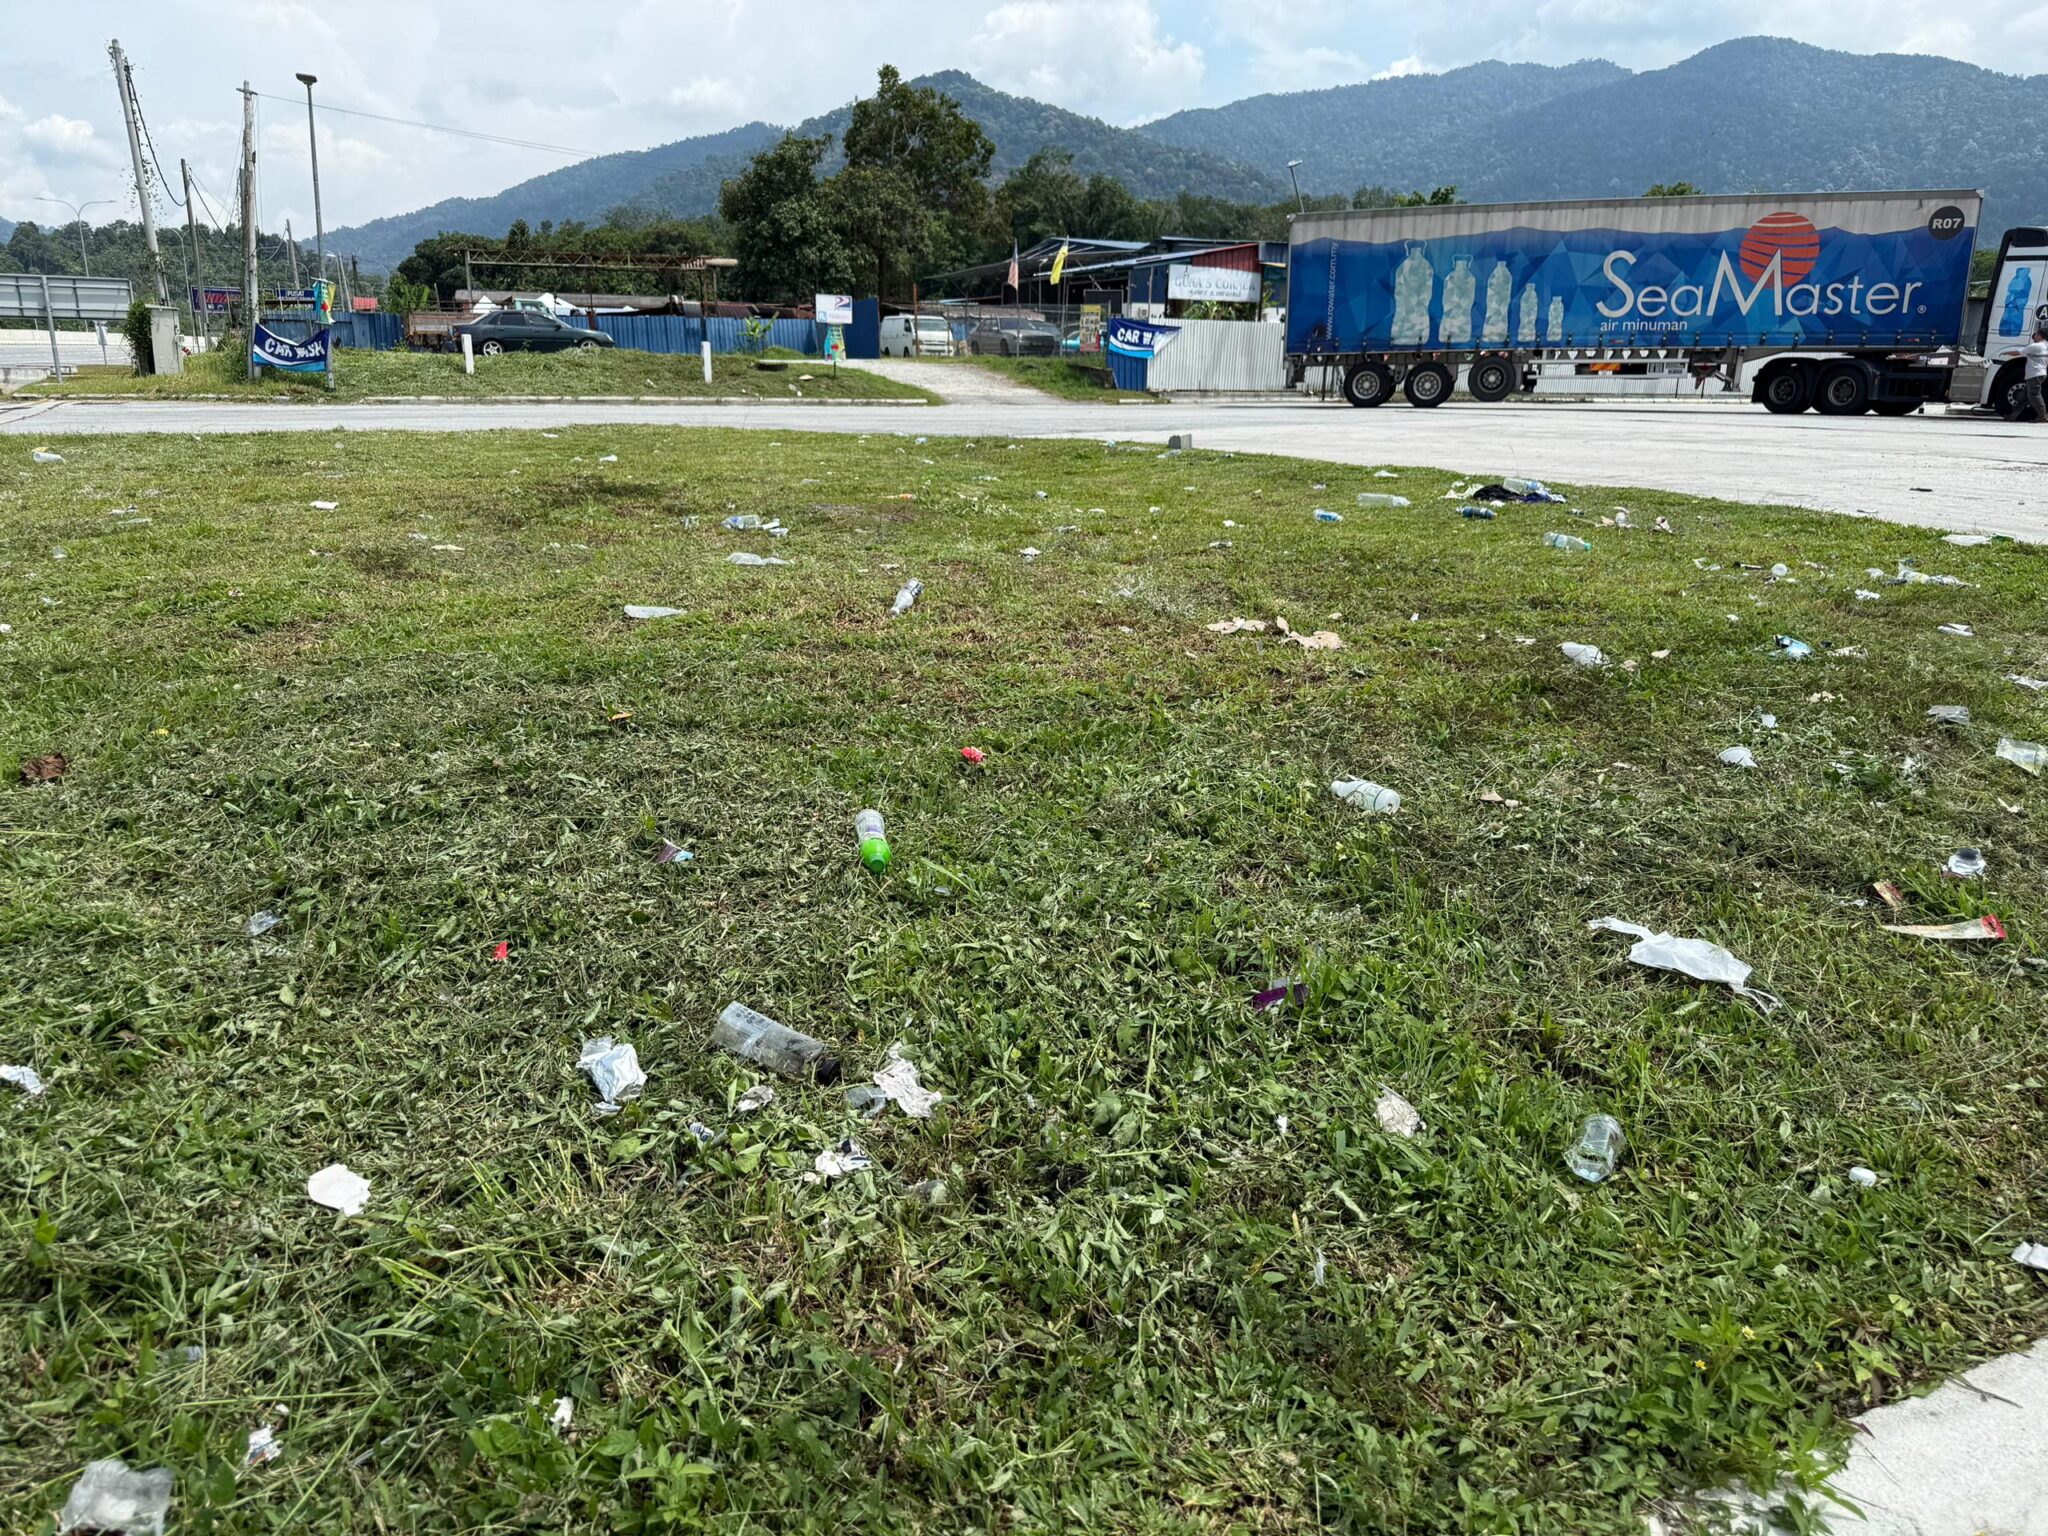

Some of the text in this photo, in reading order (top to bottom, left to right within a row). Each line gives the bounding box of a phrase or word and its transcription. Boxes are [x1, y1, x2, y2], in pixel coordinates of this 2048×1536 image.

[1932, 218, 1962, 229] R07
[1326, 242, 1339, 340] www.rowater.com.my
[1600, 320, 1687, 331] air minuman
[1117, 328, 1140, 344] CAR
[264, 338, 325, 358] CAR WASH
